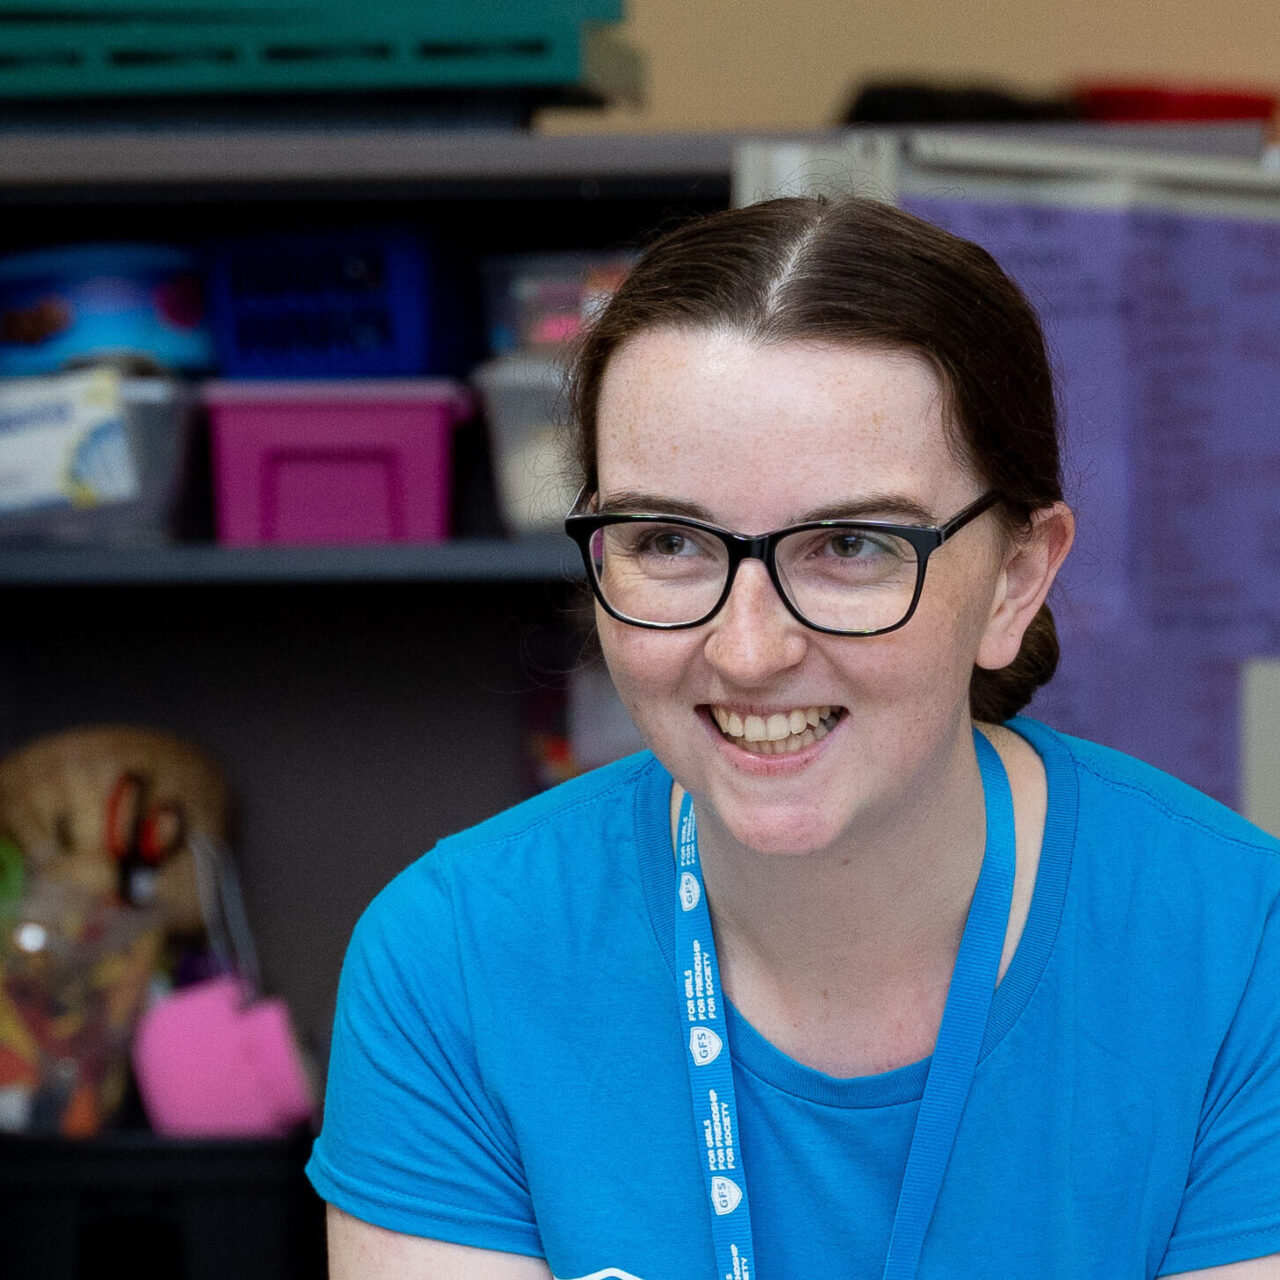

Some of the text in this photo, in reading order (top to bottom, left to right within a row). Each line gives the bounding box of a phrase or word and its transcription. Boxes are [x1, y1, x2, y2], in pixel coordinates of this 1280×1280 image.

[684, 970, 696, 1021] FOR GIRLS
[693, 940, 707, 1020] FOR FRIENDSHIP
[703, 952, 717, 1019] FOR SOCIETY
[697, 1032, 708, 1059] GFS
[703, 1119, 717, 1171] FOR GIRLS
[717, 1148, 726, 1170] FOR
[721, 1102, 735, 1169] FOR SOCIETY
[718, 1182, 728, 1208] GFS
